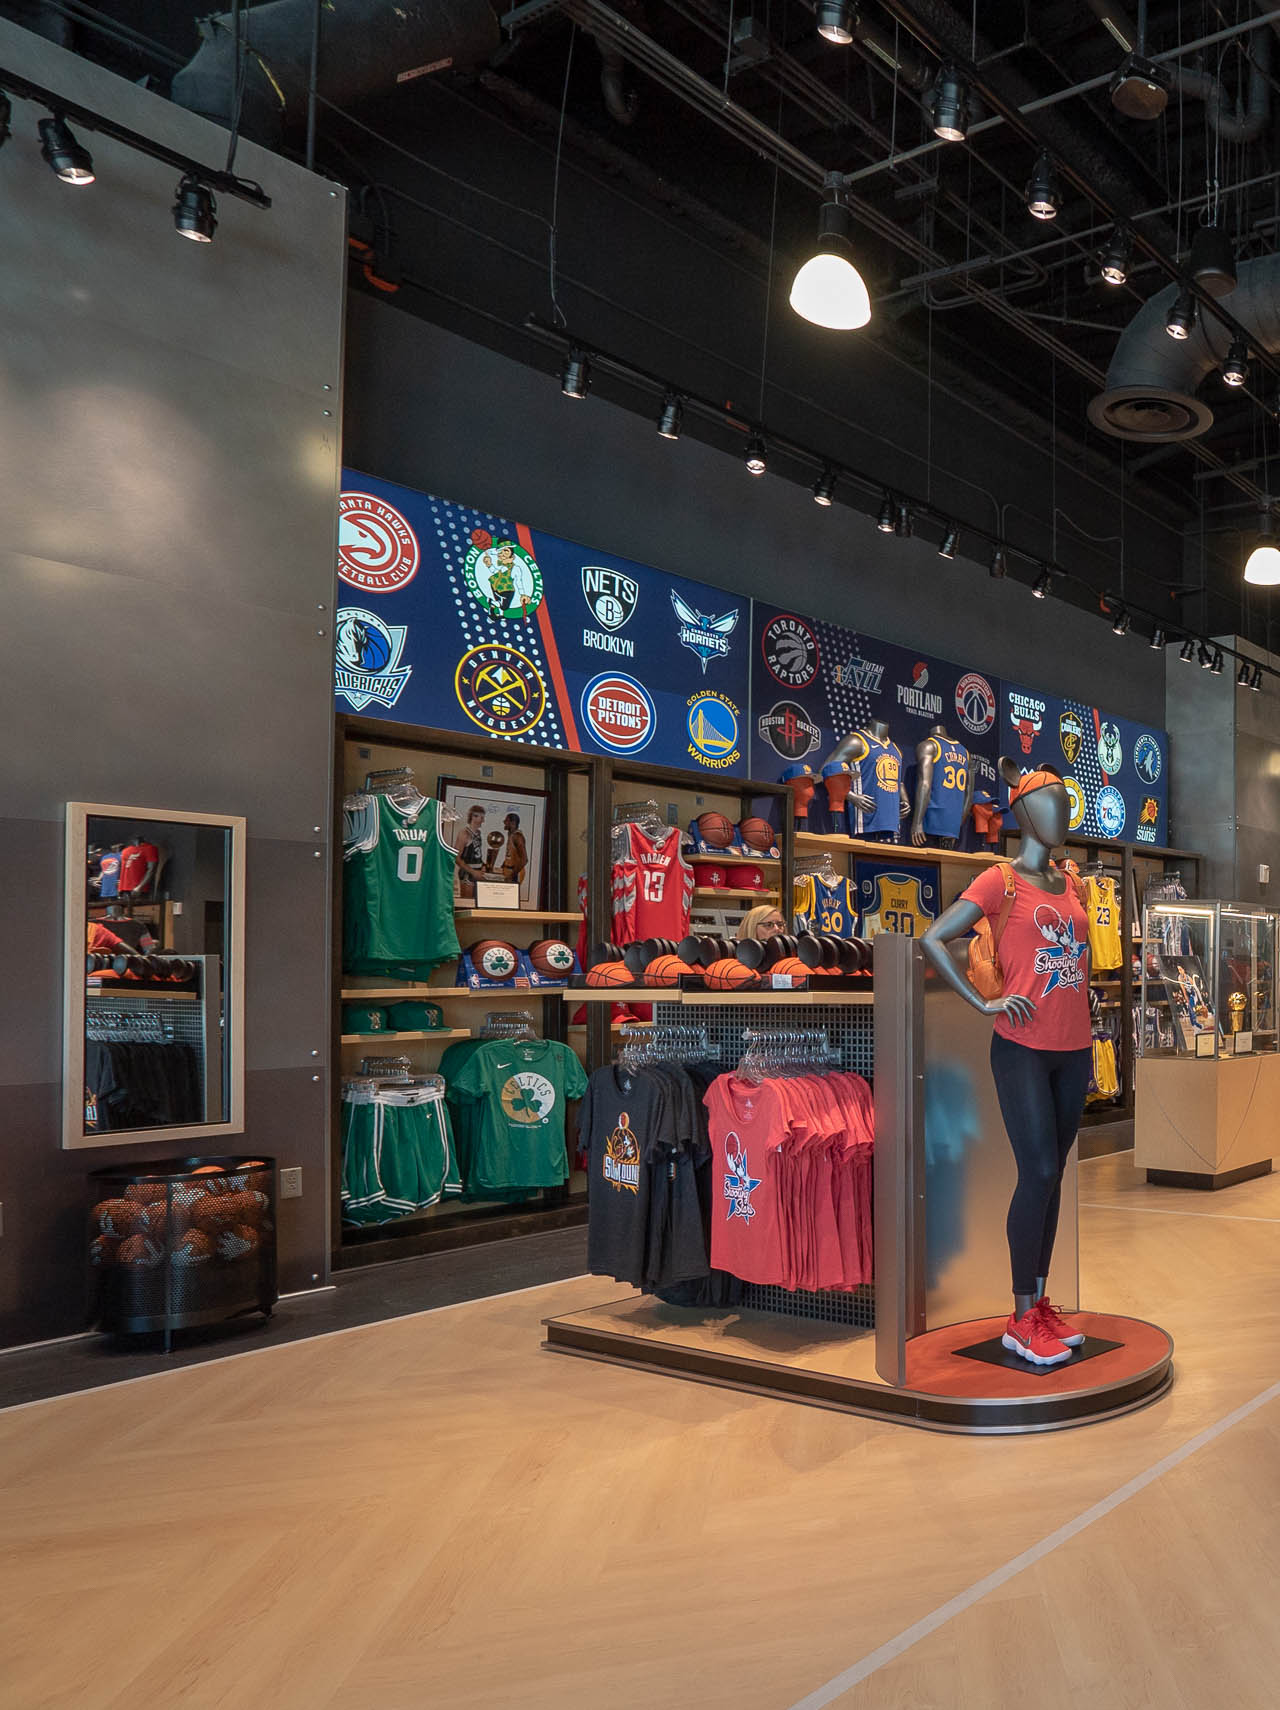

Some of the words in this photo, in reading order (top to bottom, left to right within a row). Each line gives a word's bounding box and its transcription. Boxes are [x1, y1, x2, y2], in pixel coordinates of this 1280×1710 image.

[339, 499, 372, 512] ANTA
[376, 507, 411, 545] HAWKS
[391, 557, 413, 581] CLUB
[465, 547, 484, 599] BOSTON
[524, 555, 544, 605] CELTICS
[585, 570, 635, 604] NETS
[605, 599, 614, 622] B
[583, 629, 634, 657] BROOKLYN
[682, 629, 728, 653] HORNETS
[768, 620, 815, 650] TORONTO
[468, 650, 534, 680] DENVER
[768, 655, 815, 684] RAPTORS
[866, 662, 885, 674] UTAH
[335, 671, 402, 698] AVERICKS
[597, 696, 642, 716] DETROIT
[686, 690, 718, 707] GOLDEN
[719, 694, 741, 716] STATE
[896, 684, 943, 714] PORTLAND
[1008, 692, 1046, 713] CHICAGO
[466, 699, 536, 731] NUGGETS
[597, 709, 642, 730] PISTONS
[761, 716, 785, 727] HOUSTON
[1013, 705, 1040, 722] BULLS
[797, 719, 819, 738] ROCKETS
[687, 743, 741, 769] WARRIORS
[944, 751, 967, 766] CURRY
[943, 765, 967, 791] 30
[392, 828, 428, 843] TATUM
[1136, 830, 1157, 843] SUNS
[397, 846, 424, 882] 0
[640, 852, 672, 867] HARDEN
[643, 870, 666, 903] 13
[820, 911, 844, 933] 30
[884, 909, 915, 938] 30
[1096, 906, 1111, 927] 23
[485, 946, 513, 962] CELTICS
[1034, 951, 1078, 974] Shooting
[1058, 967, 1084, 987] Stars
[505, 1075, 552, 1097] CELTICS
